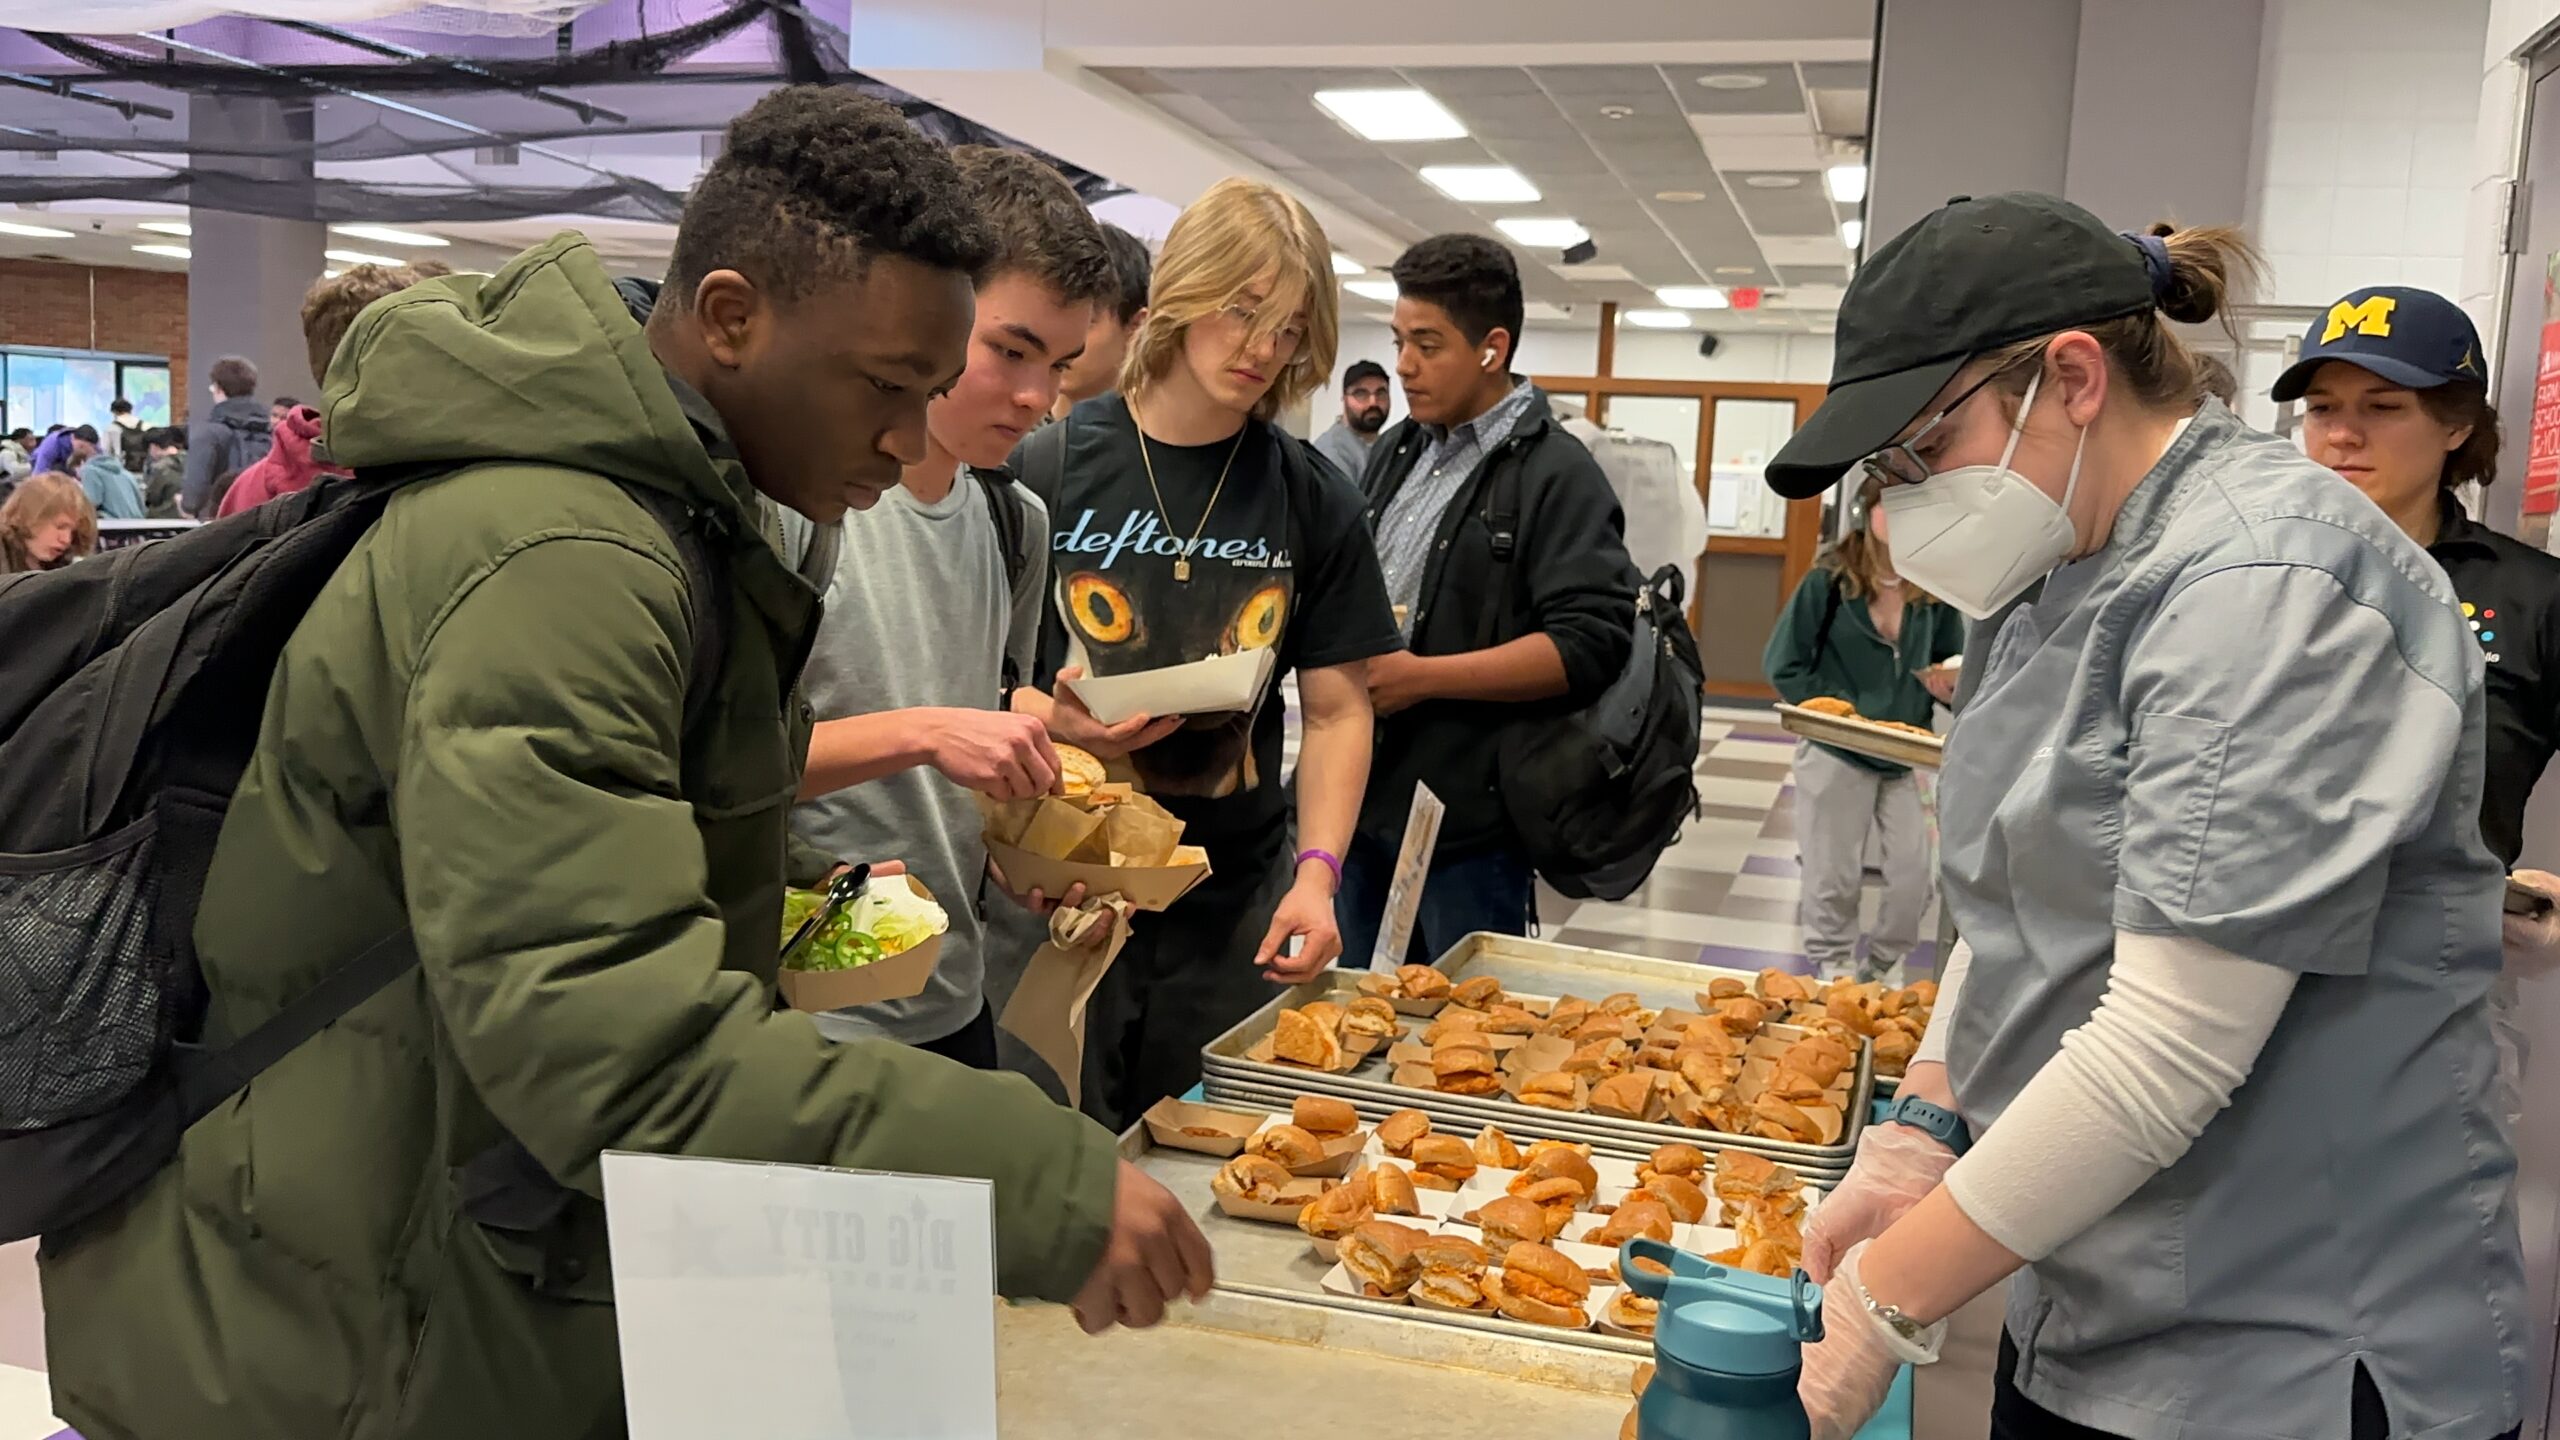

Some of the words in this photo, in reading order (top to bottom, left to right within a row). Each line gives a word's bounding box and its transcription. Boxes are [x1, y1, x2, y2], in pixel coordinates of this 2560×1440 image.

[2320, 296, 2396, 346] M
[1053, 508, 1268, 570] deftones
[1232, 551, 1271, 569] around
